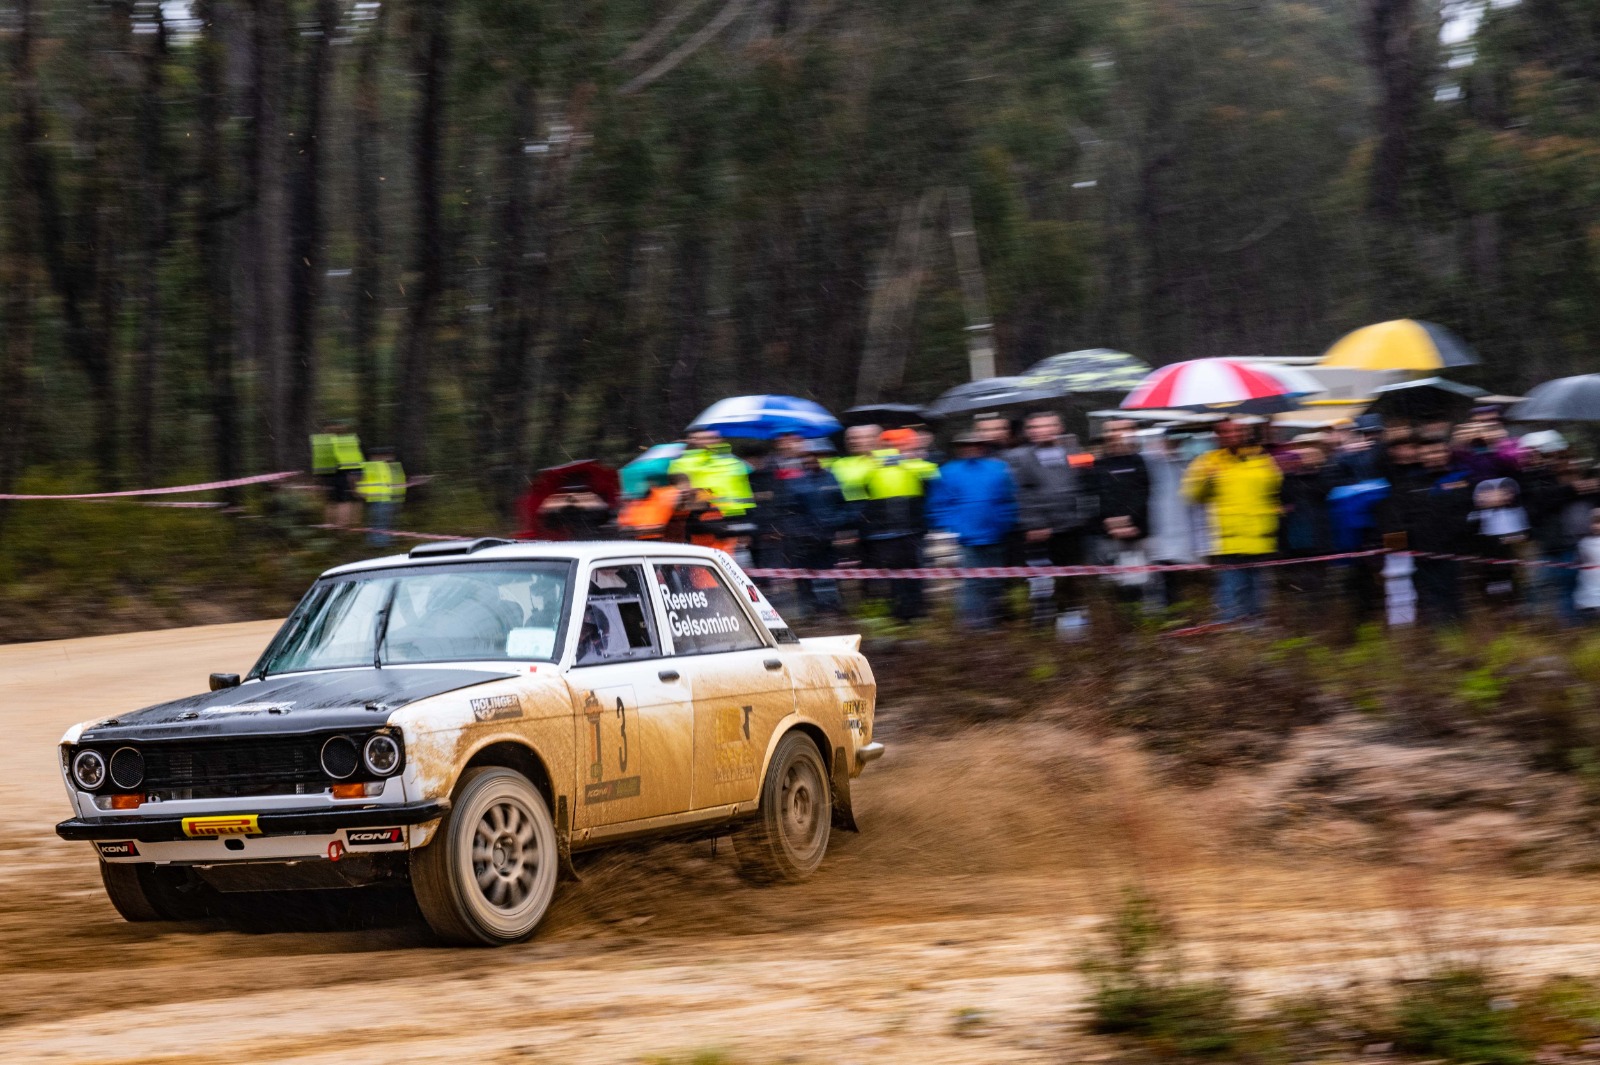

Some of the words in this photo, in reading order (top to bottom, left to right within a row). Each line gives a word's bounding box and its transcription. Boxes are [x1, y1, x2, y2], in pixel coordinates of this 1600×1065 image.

[660, 583, 708, 610] Reeves
[668, 611, 740, 638] Gelsomino
[471, 695, 519, 711] HOLINGER
[188, 819, 253, 835] PIRELLI
[349, 832, 391, 841] KONI
[101, 845, 128, 853] KONI
